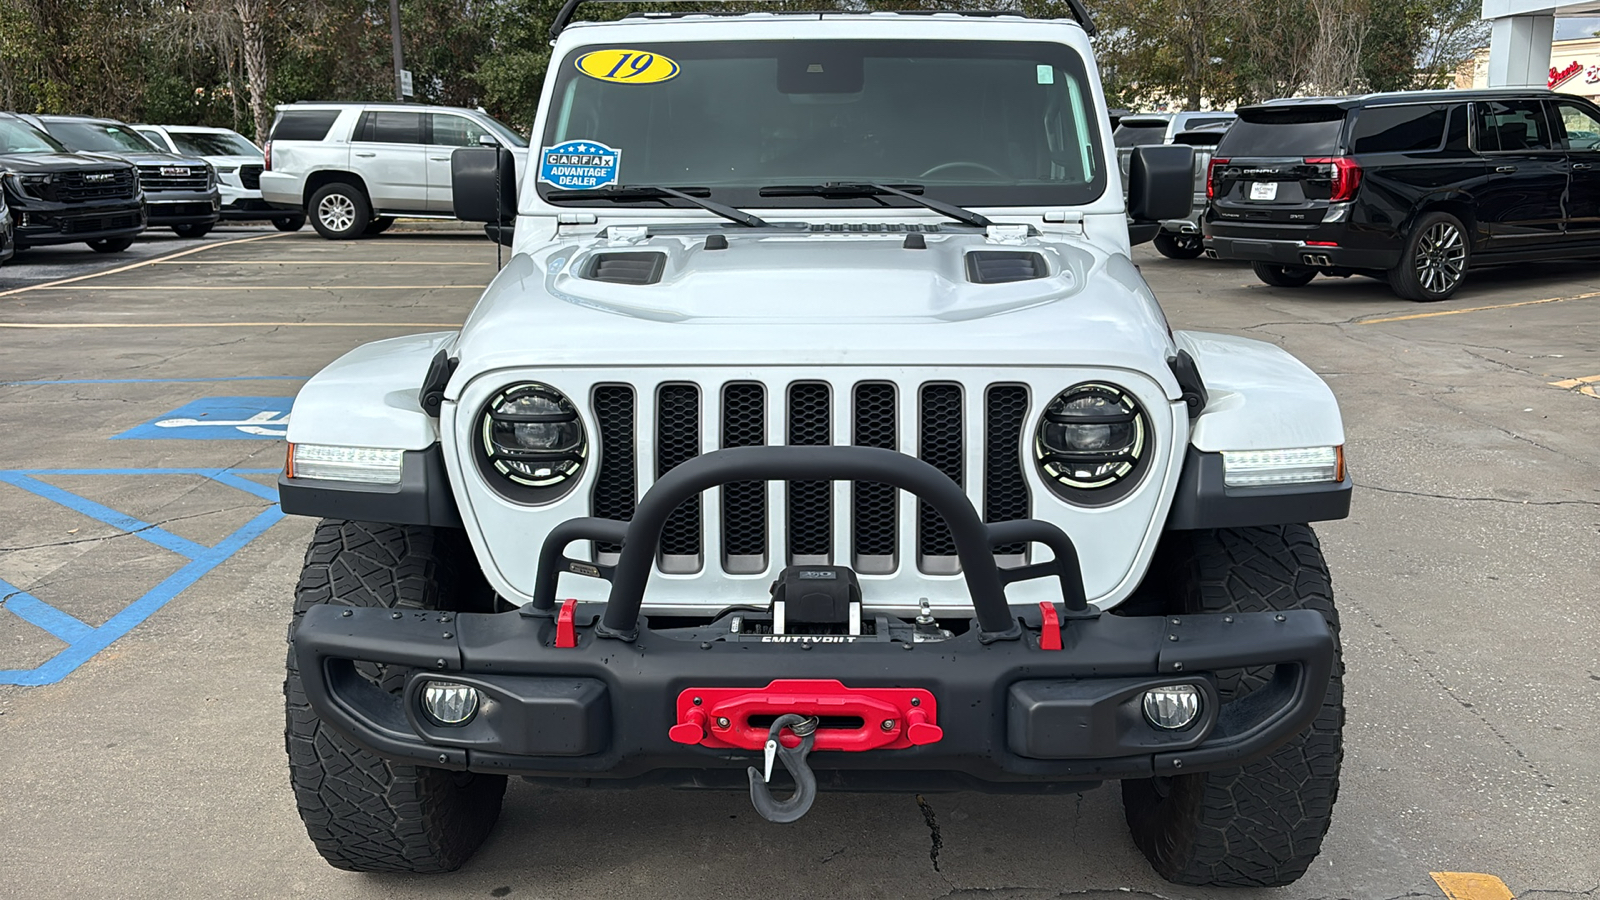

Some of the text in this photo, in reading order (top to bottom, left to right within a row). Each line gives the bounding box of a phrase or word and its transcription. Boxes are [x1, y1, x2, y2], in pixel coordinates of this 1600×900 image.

[601, 53, 654, 79] 19
[548, 155, 613, 167] CARFAX
[550, 167, 608, 177] ADVANTAGE
[559, 176, 597, 186] DEALER
